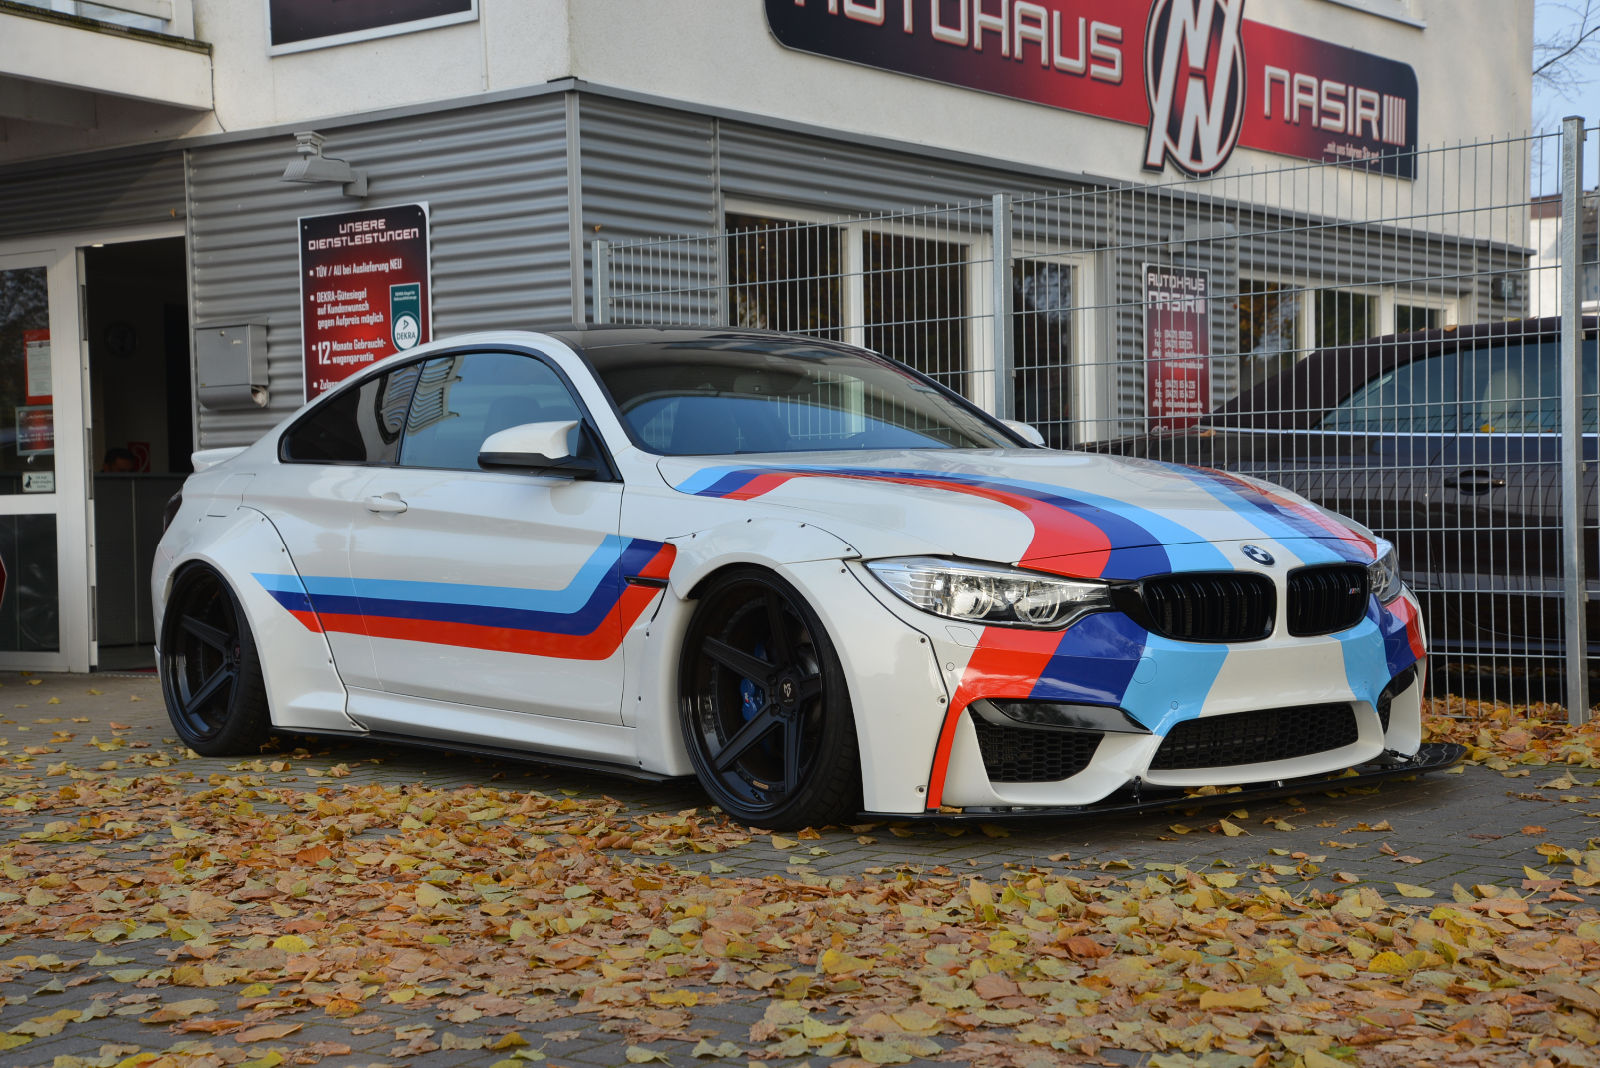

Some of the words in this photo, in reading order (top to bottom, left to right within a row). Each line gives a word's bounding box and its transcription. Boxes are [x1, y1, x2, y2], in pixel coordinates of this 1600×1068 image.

[795, 0, 1122, 85] OHAUS
[1264, 64, 1380, 141] NASIR
[339, 219, 386, 234] UNSERE
[308, 228, 419, 250] DIENSTLEISTUNGEN
[316, 264, 327, 278] TÜV
[333, 265, 342, 276] AU
[343, 264, 352, 275] bei
[353, 261, 389, 274] Auslieferung
[390, 258, 402, 270] NEU
[1148, 273, 1205, 291] AUTOHAUS
[317, 288, 367, 303] DEKRA-Gütesiegel
[317, 304, 326, 316] auf
[327, 300, 369, 315] Kundenwunsch
[317, 318, 335, 330] gegen
[336, 315, 360, 327] Aufpreis
[361, 312, 384, 326] möglich
[396, 331, 416, 341] DEKRA
[318, 341, 331, 365] 12
[332, 341, 353, 351] Monate
[332, 352, 374, 366] wagengarantie
